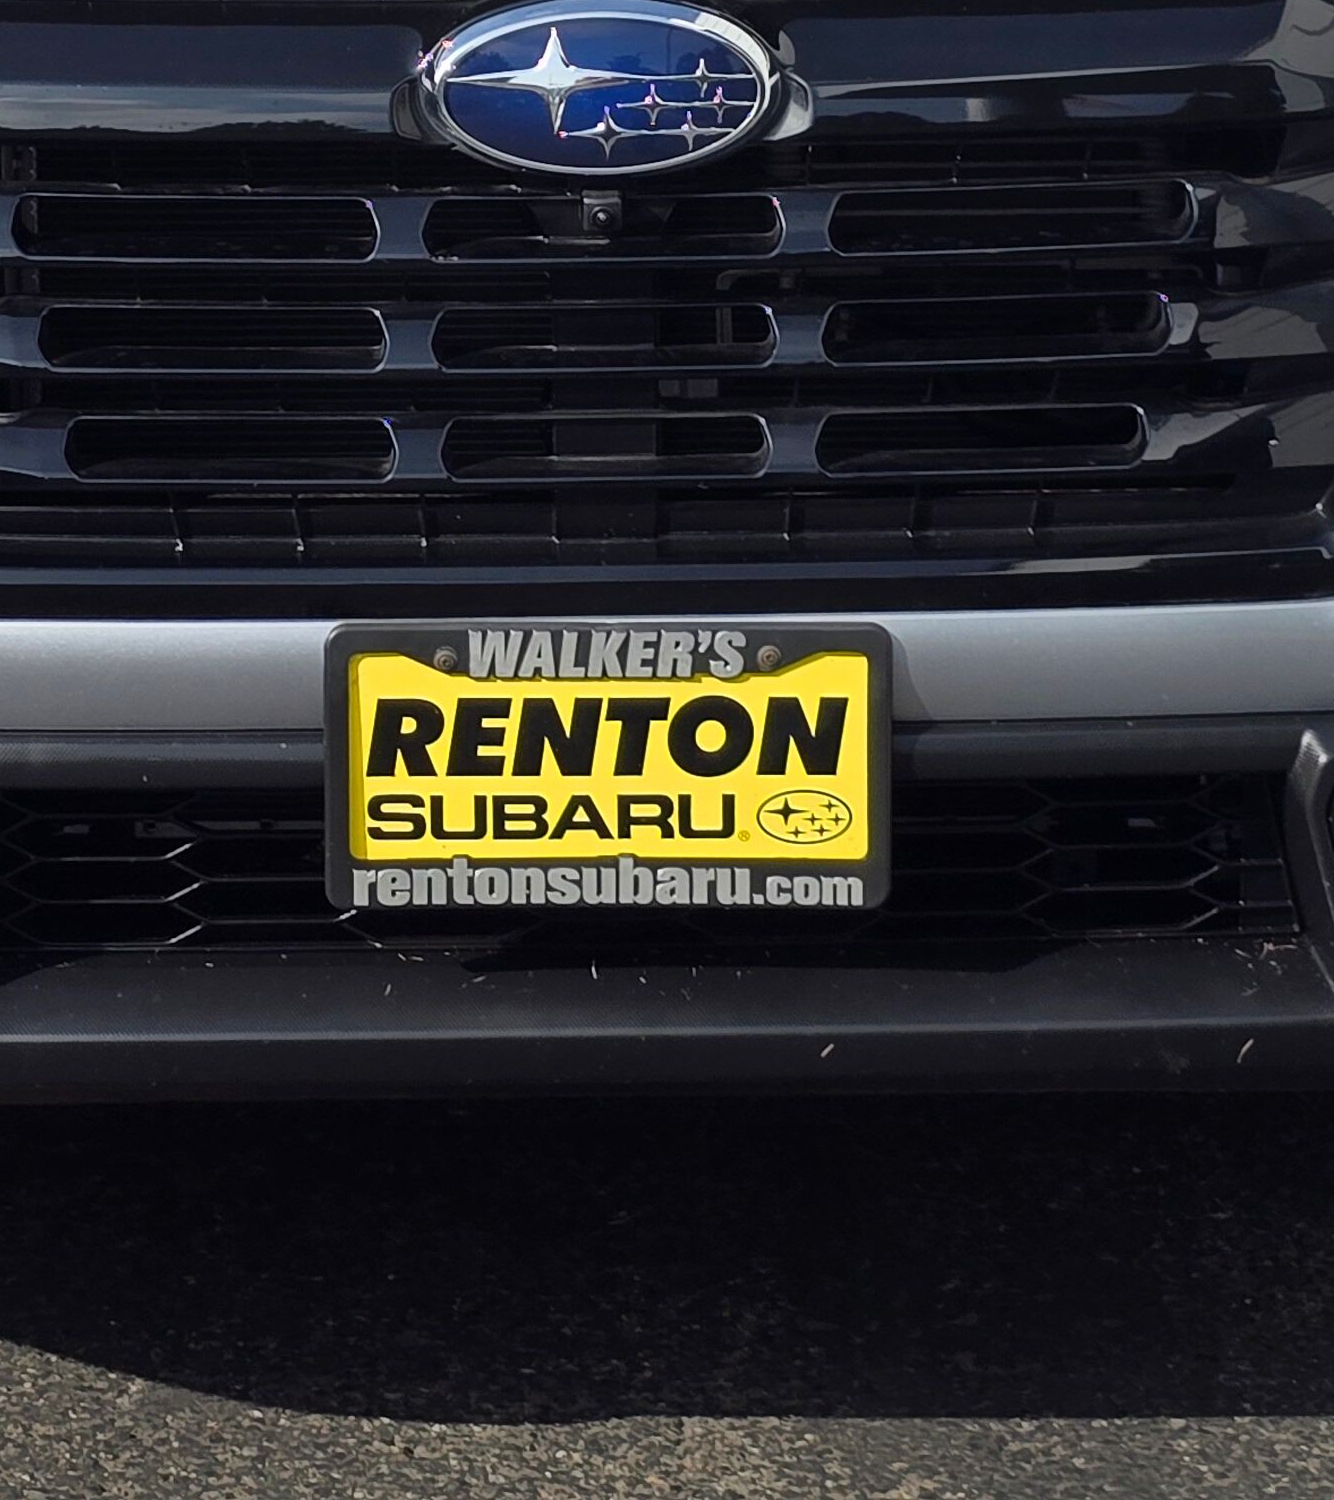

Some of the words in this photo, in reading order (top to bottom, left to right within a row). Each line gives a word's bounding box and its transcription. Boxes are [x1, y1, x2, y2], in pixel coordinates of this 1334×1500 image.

[468, 629, 747, 679] WALKER'S
[367, 695, 849, 778] RENTON
[368, 794, 736, 840] SUBARU
[353, 857, 864, 907] rentonsubaru.com
